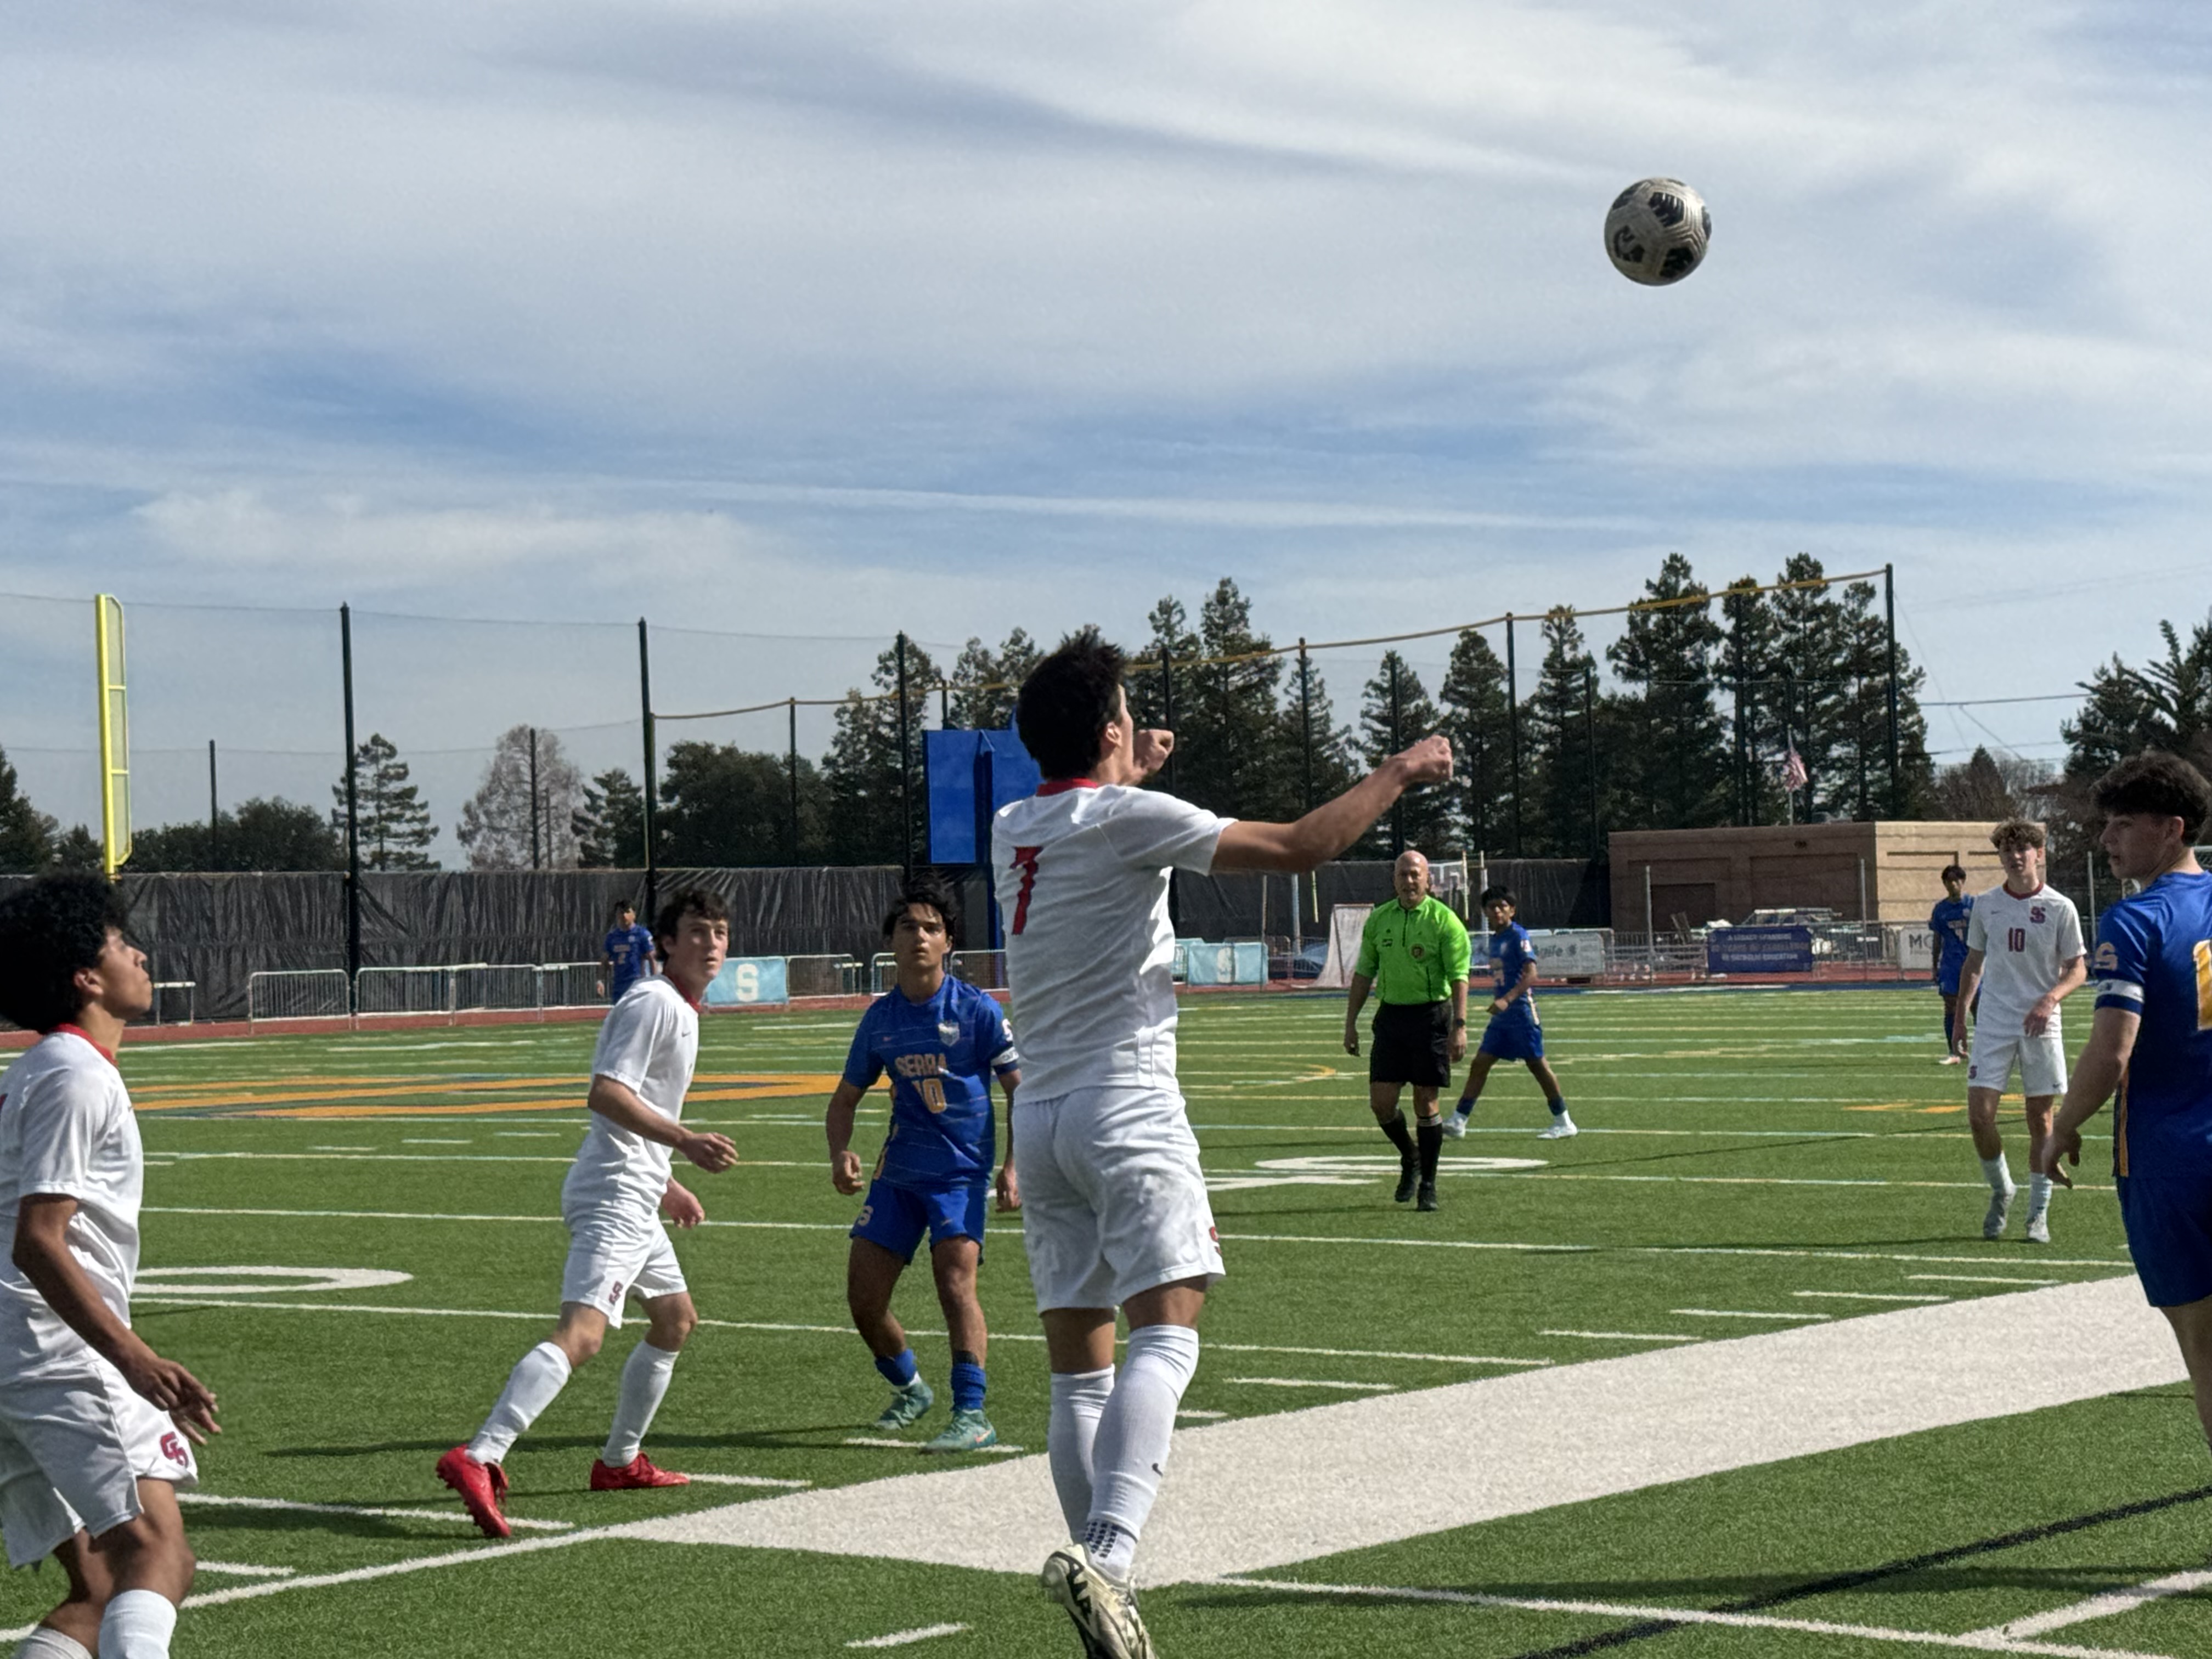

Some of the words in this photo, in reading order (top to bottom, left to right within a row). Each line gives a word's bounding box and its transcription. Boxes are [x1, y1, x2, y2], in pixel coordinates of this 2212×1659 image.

[1009, 845, 1044, 935] 7
[2008, 927, 2025, 952] 10
[2094, 942, 2118, 970] S
[735, 963, 759, 1003] S
[894, 1052, 947, 1076] SERRA
[911, 1079, 947, 1114] 10
